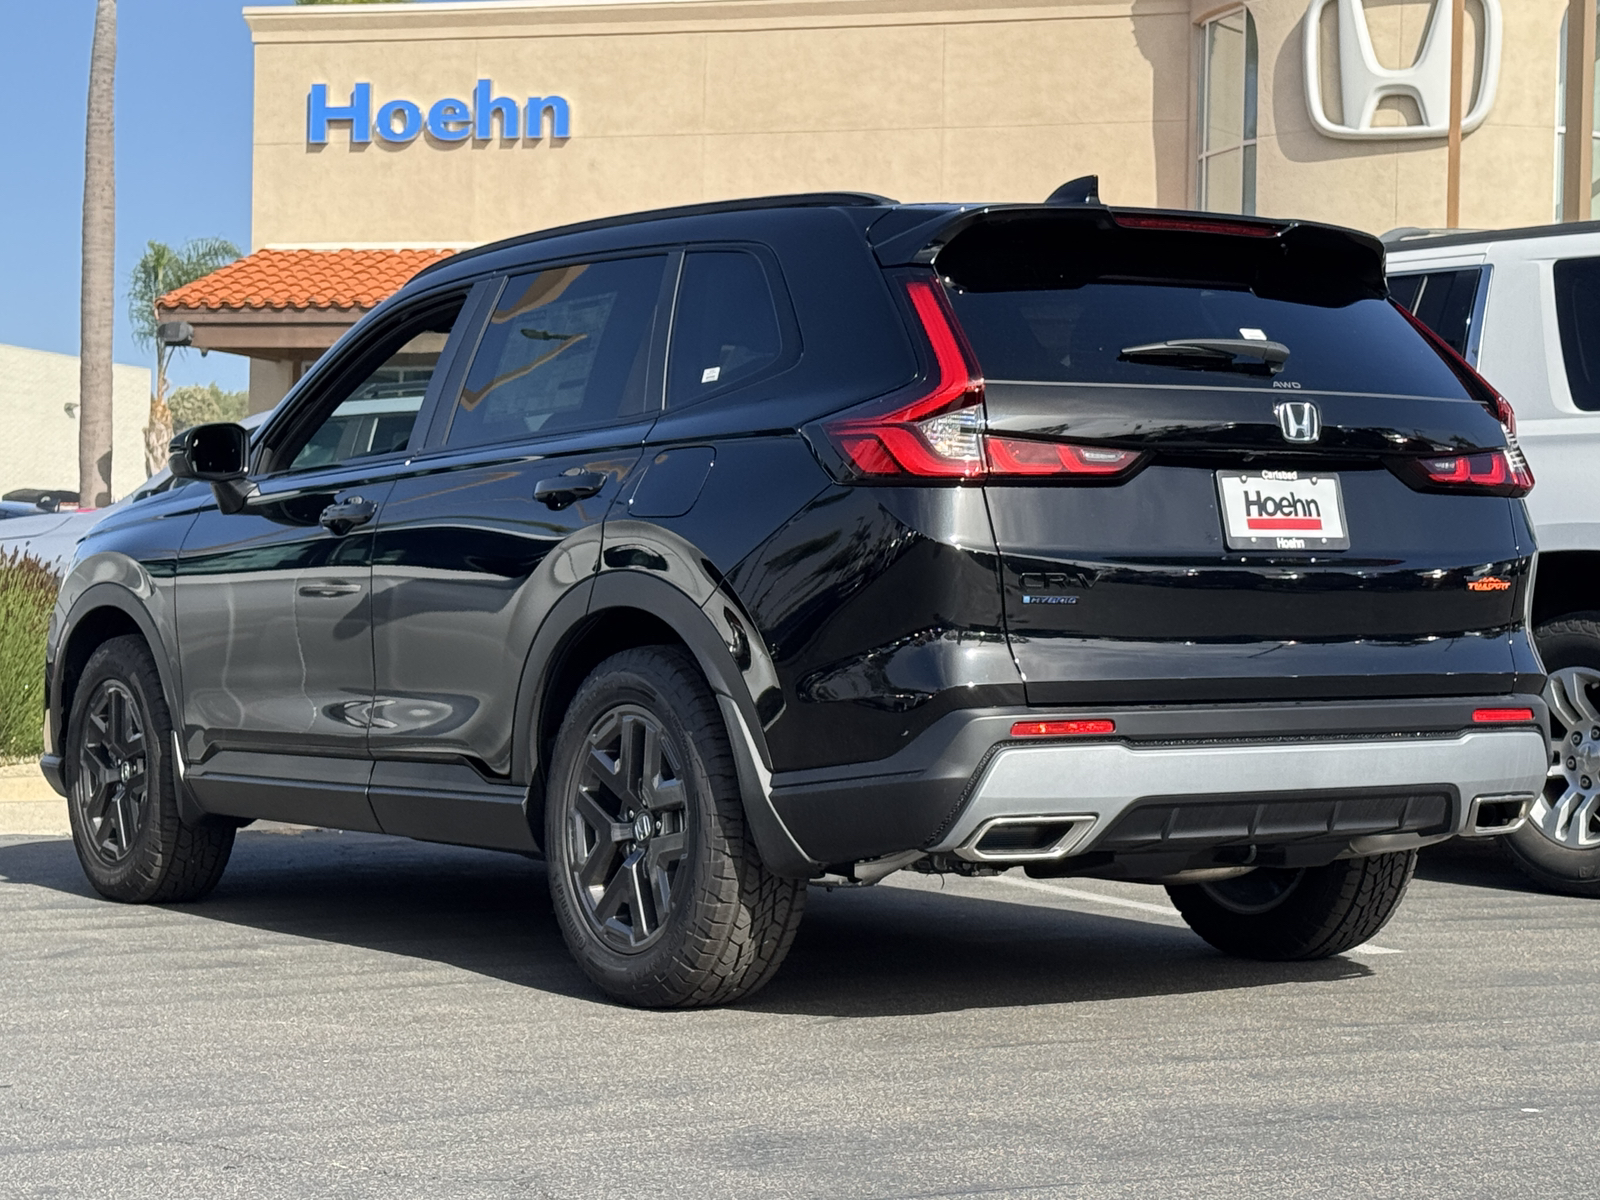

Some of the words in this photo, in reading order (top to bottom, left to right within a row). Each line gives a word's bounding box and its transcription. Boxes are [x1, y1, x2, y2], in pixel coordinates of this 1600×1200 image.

[306, 78, 571, 144] Hoehn
[1273, 381, 1301, 389] AWD
[1262, 470, 1298, 480] Carlsbad
[1243, 490, 1321, 517] Hoehn
[1276, 537, 1305, 549] Hoehn
[1019, 571, 1102, 589] CR-V
